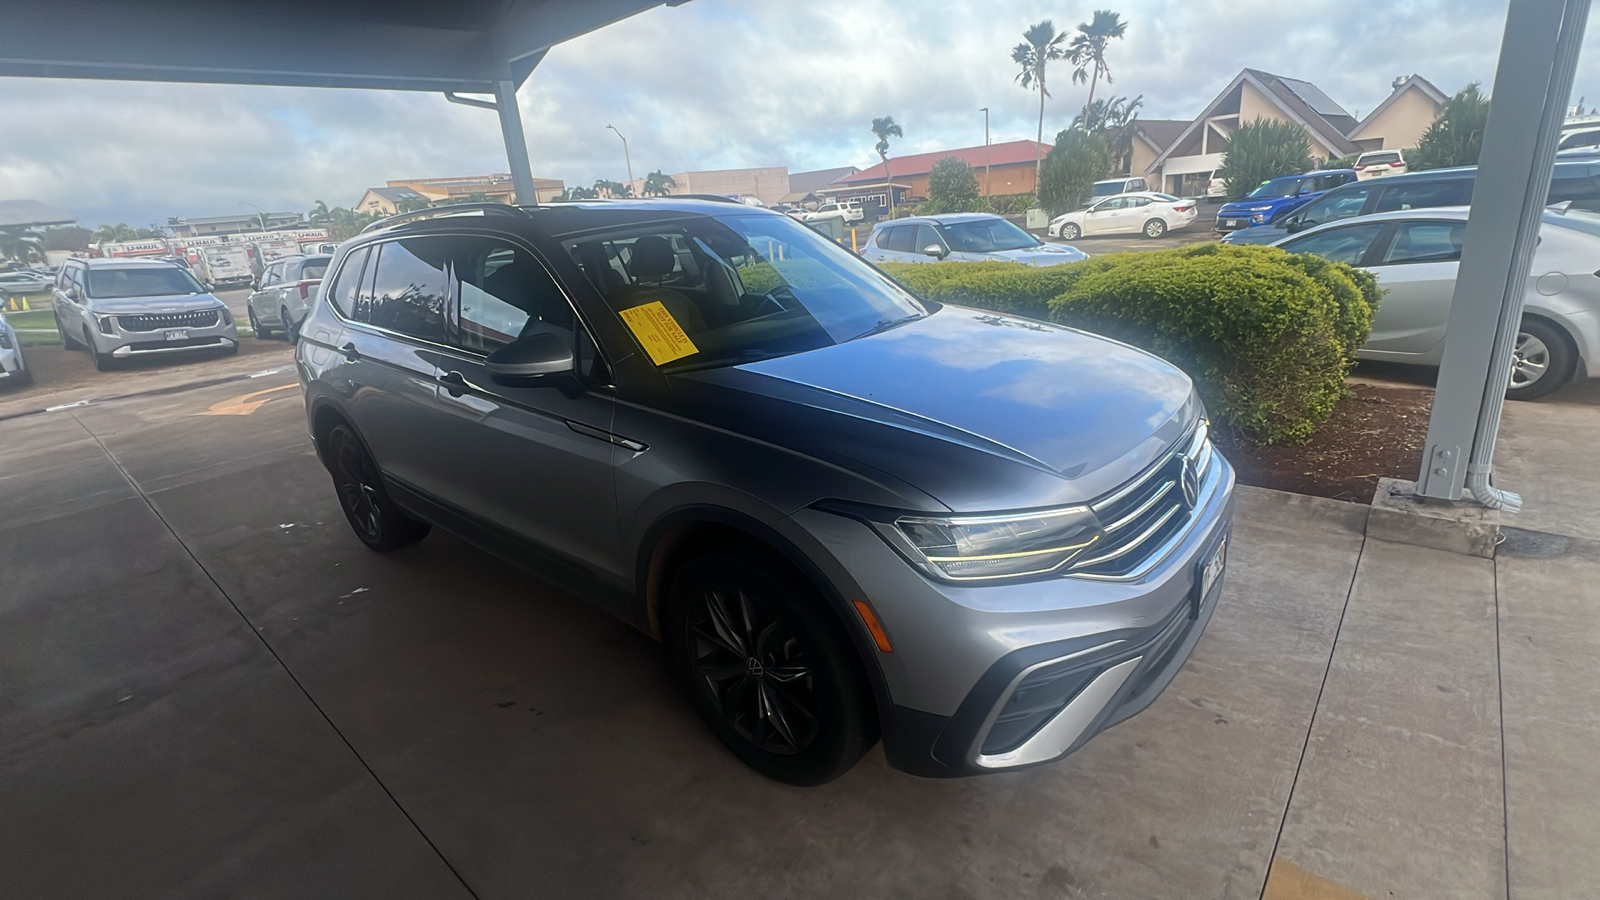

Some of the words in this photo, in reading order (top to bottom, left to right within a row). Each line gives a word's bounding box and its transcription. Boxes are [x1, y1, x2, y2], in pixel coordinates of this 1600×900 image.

[657, 312, 667, 322] NOT
[665, 322, 673, 332] FOR
[672, 332, 683, 344] SALE
[668, 317, 685, 338] VEHICLE
